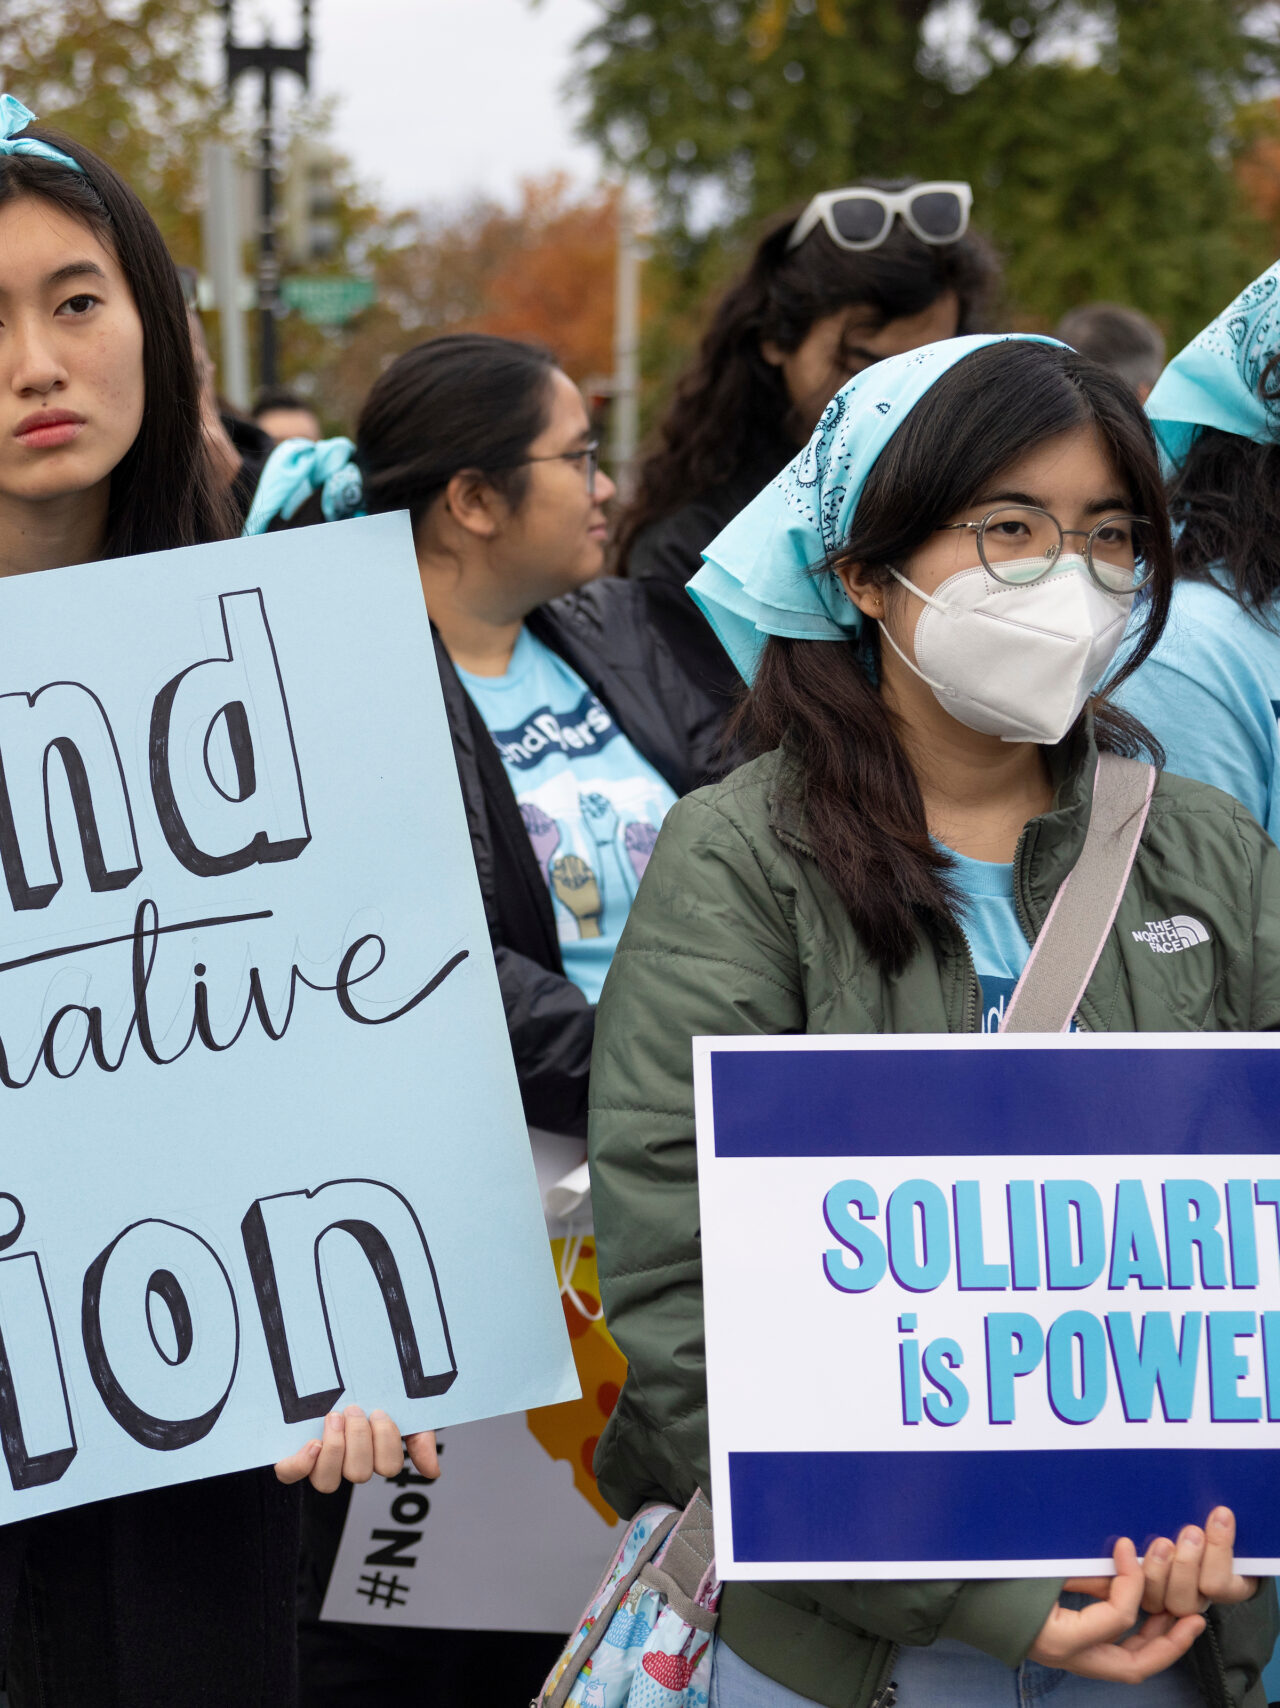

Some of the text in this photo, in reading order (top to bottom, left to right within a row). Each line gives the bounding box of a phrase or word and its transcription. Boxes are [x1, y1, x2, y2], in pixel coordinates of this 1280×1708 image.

[1144, 919, 1175, 933] THE
[1131, 929, 1180, 943] NORTH
[1149, 940, 1184, 954] FACE
[898, 1312, 970, 1427] is
[356, 1442, 444, 1610] #Not
